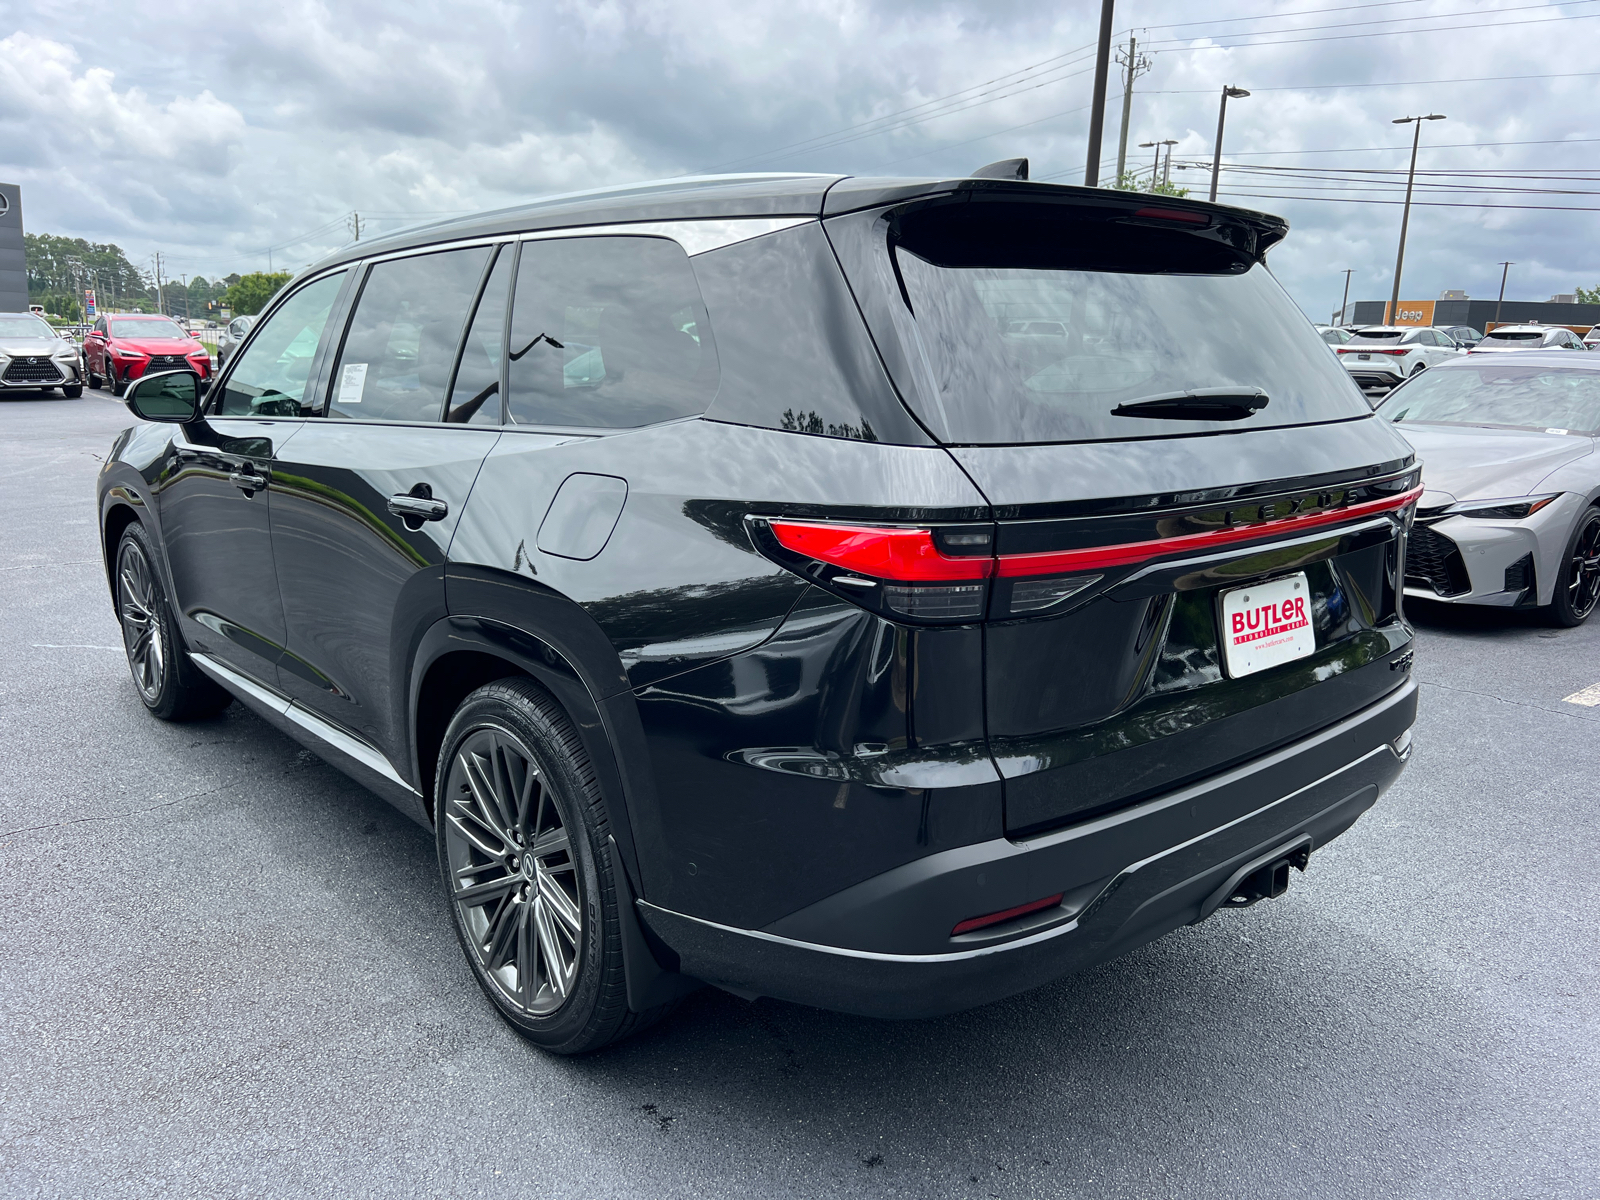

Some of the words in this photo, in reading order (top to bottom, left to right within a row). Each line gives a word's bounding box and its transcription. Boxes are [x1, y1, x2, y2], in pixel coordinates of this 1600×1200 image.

[1395, 308, 1423, 322] Jeep
[1225, 489, 1357, 526] LEXUS
[1234, 628, 1281, 645] AUTOMOTIVE
[1286, 619, 1308, 631] GROUP
